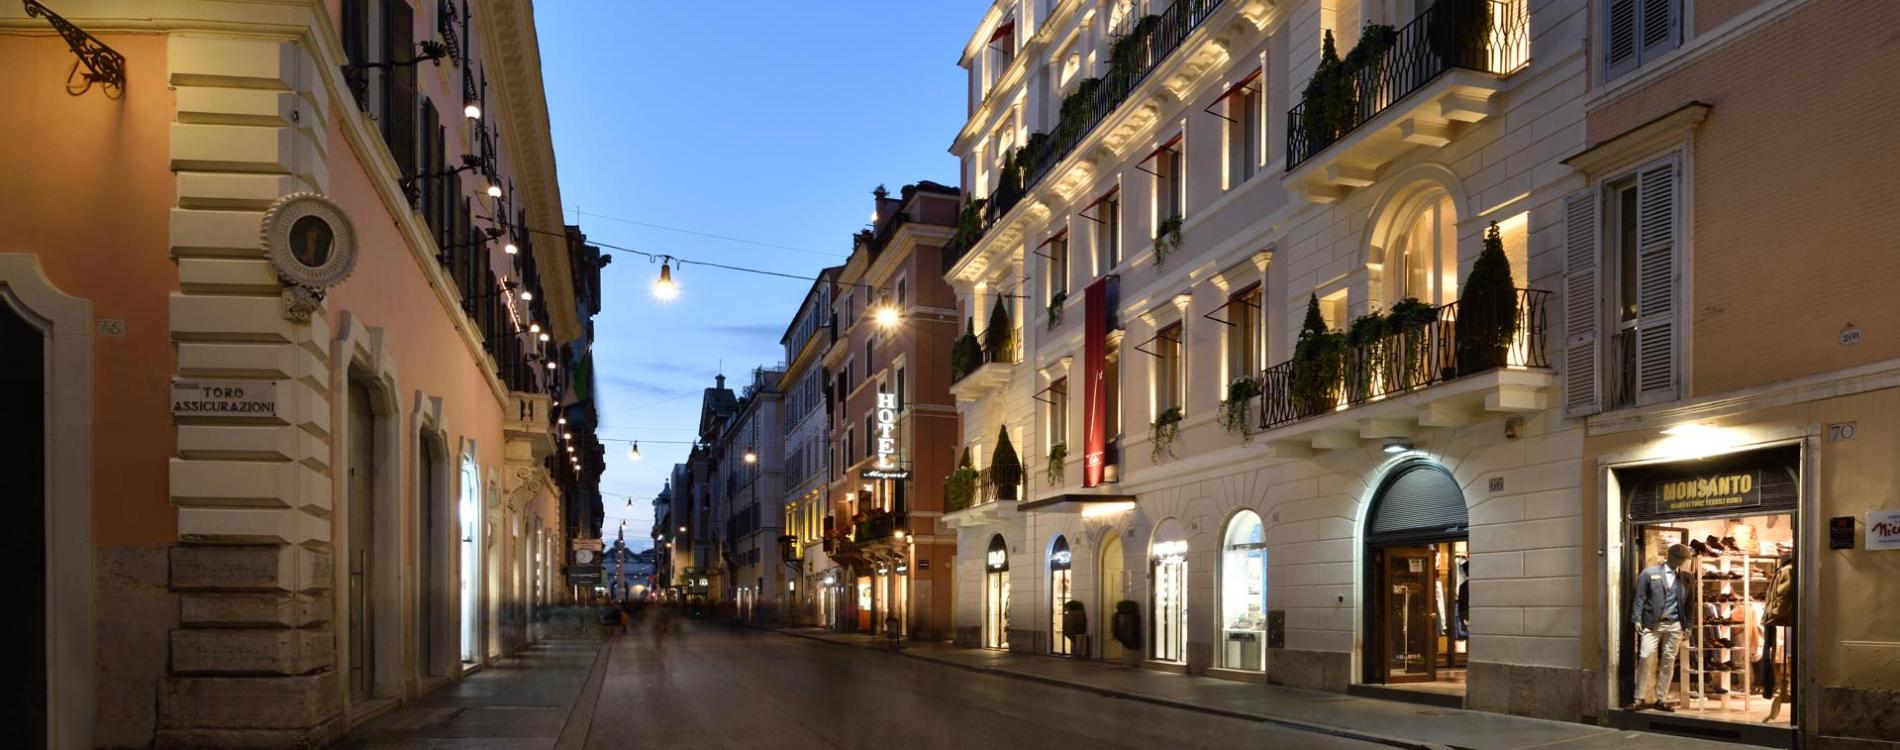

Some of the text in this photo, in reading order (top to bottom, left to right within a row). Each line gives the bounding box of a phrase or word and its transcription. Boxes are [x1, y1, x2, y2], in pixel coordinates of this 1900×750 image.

[203, 387, 245, 399] TORO
[174, 401, 276, 413] ASSICURAZIONI
[878, 393, 895, 469] HOTEL
[1831, 423, 1855, 441] 70
[1663, 474, 1752, 501] MONSANTO
